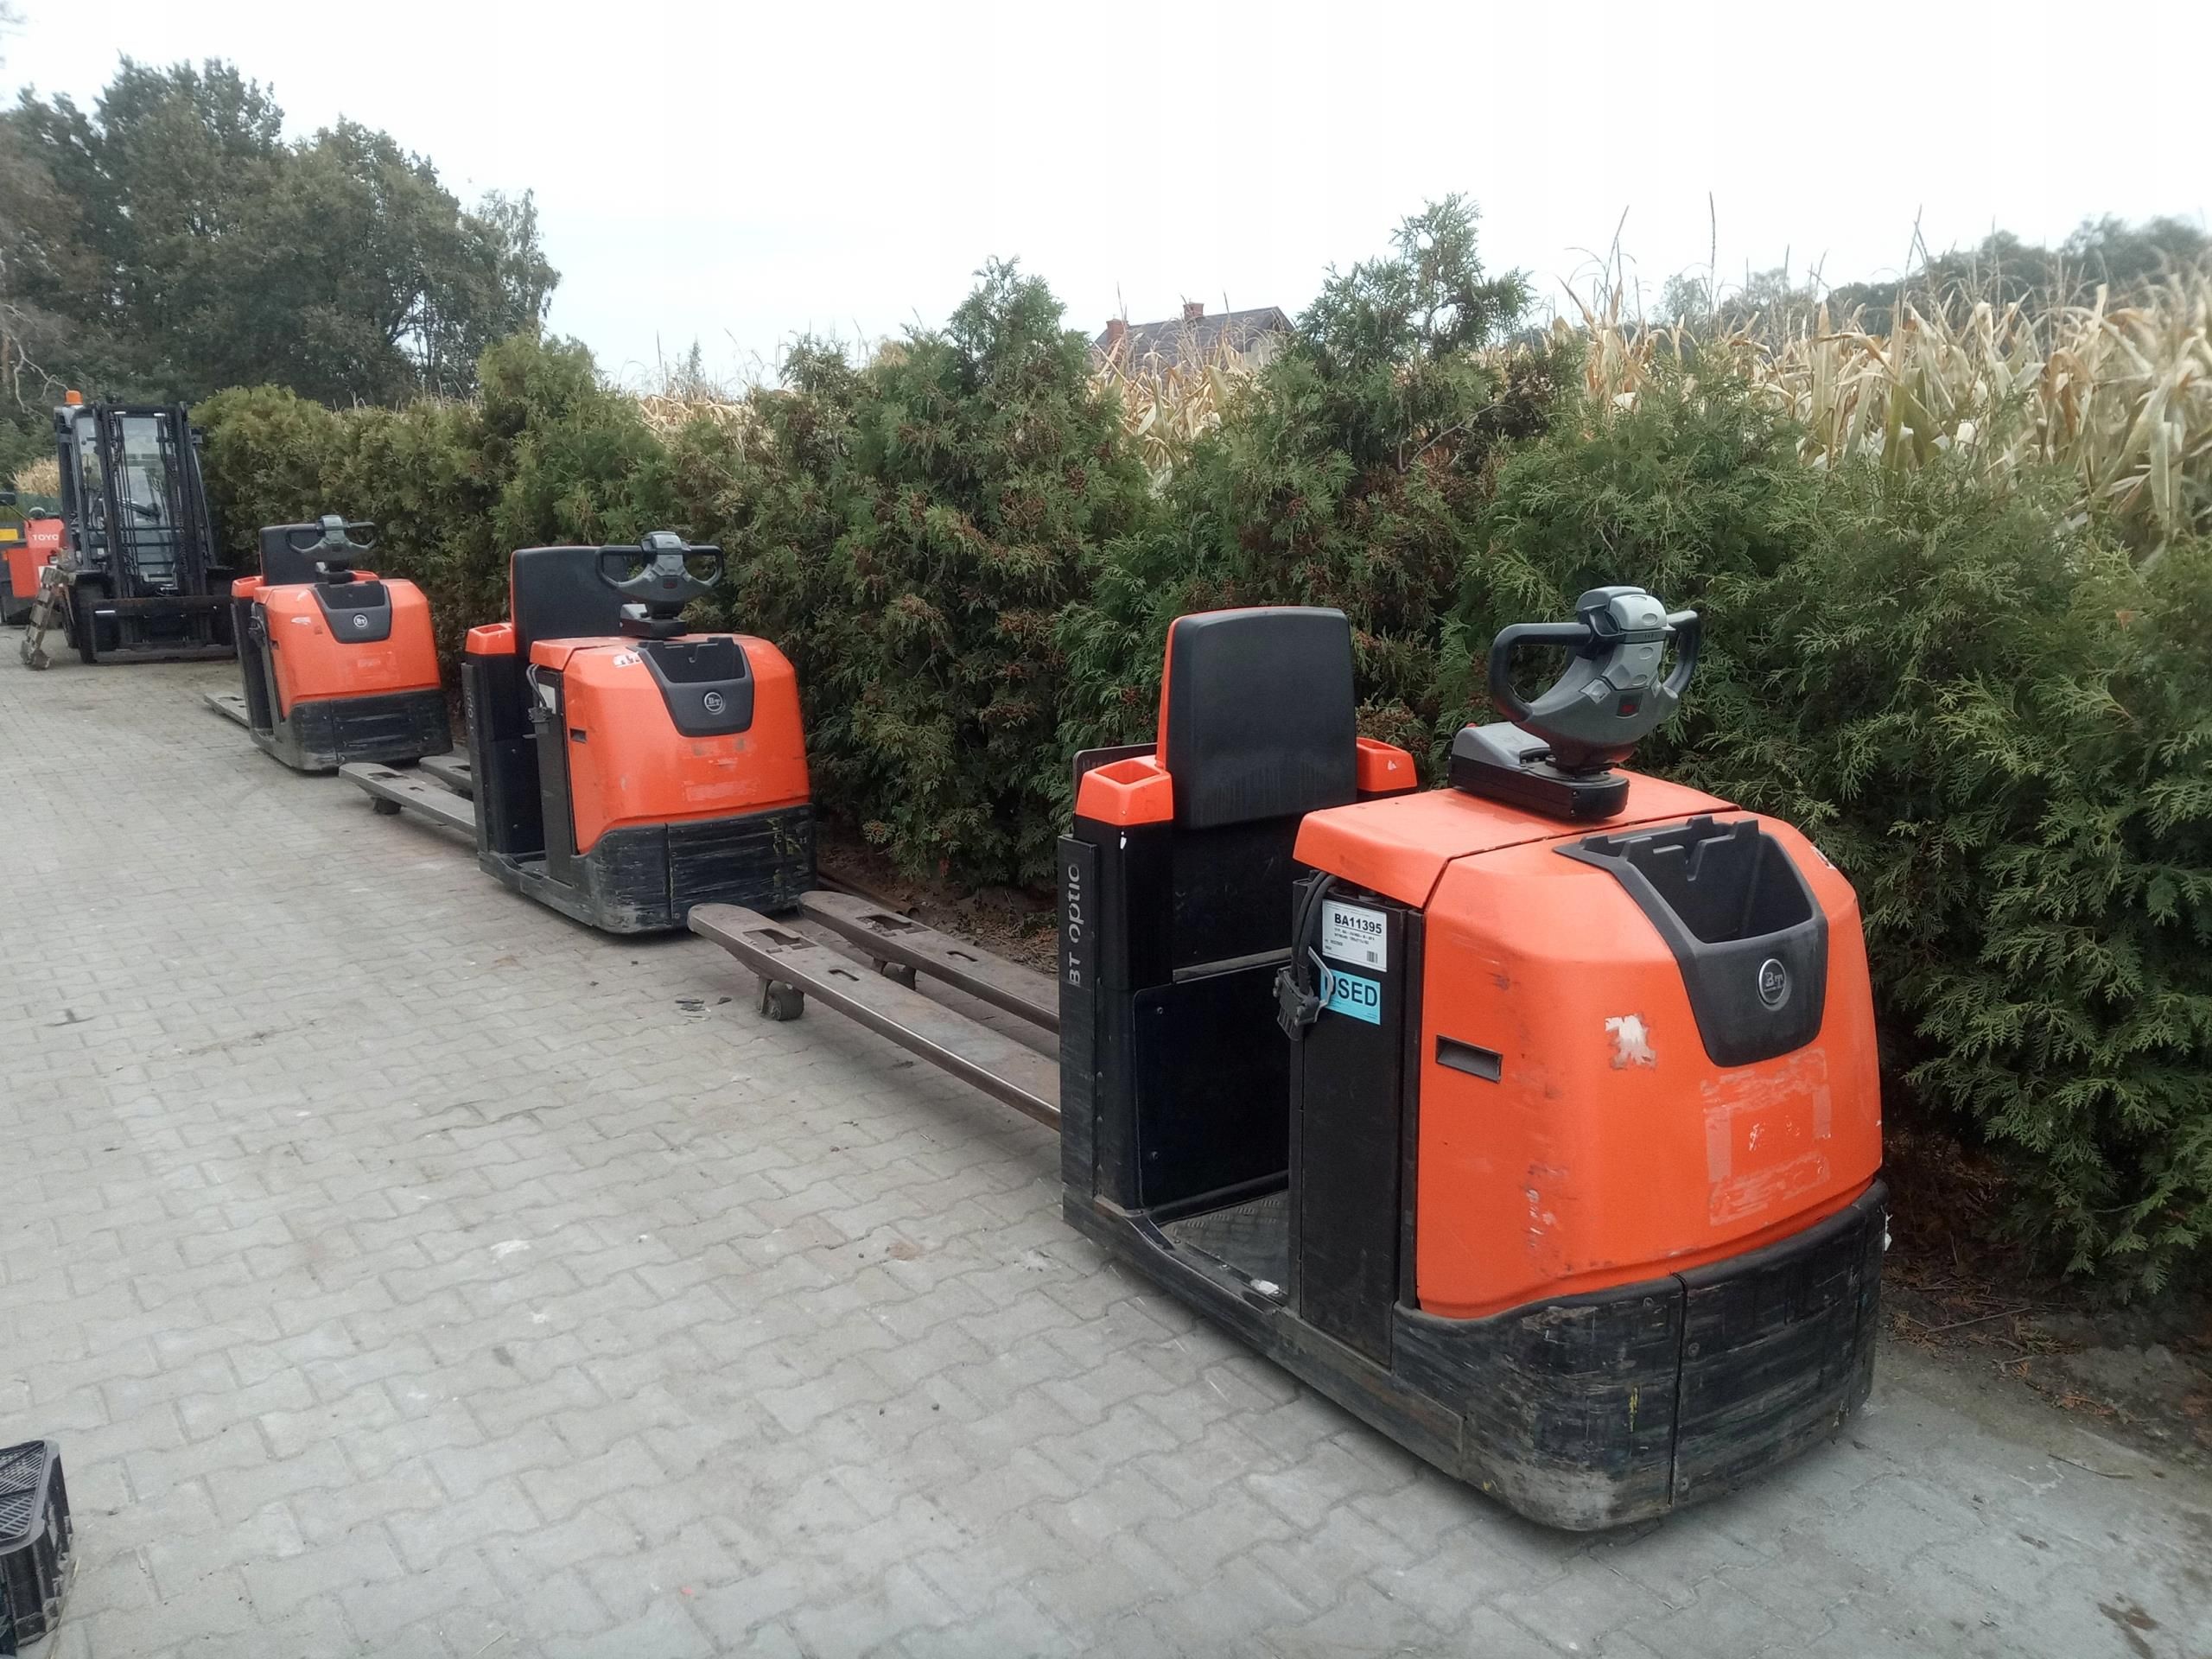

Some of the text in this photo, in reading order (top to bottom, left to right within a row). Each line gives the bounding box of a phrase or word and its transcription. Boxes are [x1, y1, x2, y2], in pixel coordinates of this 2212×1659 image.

[708, 697, 721, 706] BT
[1334, 912, 1382, 934] BA11395
[1068, 951, 1081, 988] BT
[1764, 971, 1783, 989] BT
